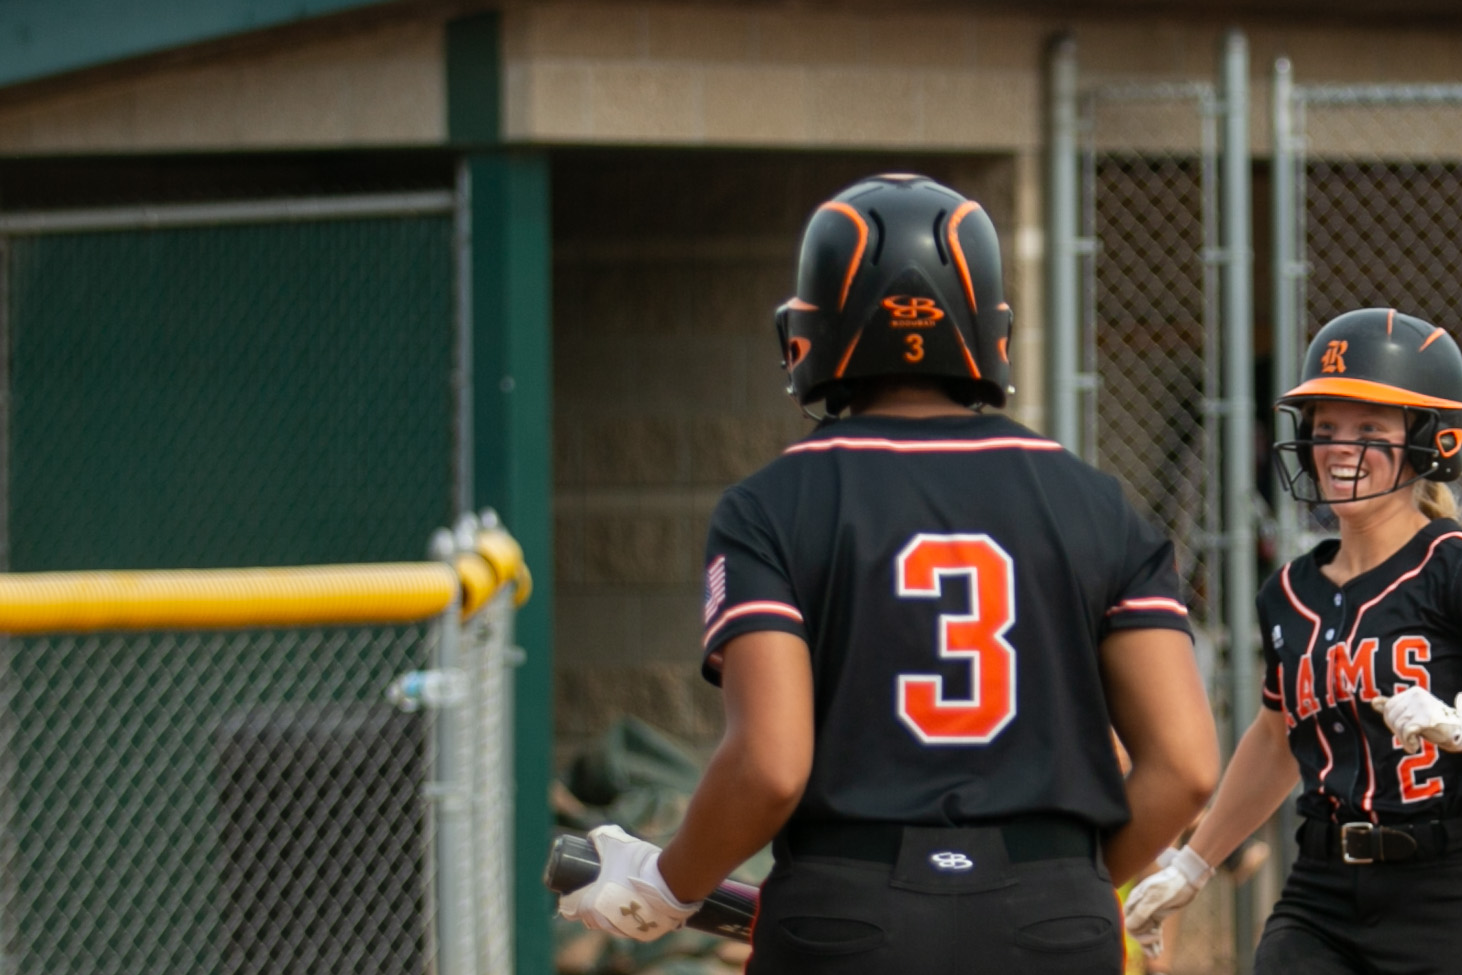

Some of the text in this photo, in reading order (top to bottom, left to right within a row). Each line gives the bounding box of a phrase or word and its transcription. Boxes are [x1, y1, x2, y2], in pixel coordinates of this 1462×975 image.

[904, 334, 924, 362] 3
[1321, 340, 1348, 373] R
[897, 533, 1016, 744] 3
[1393, 735, 1444, 803] 2
